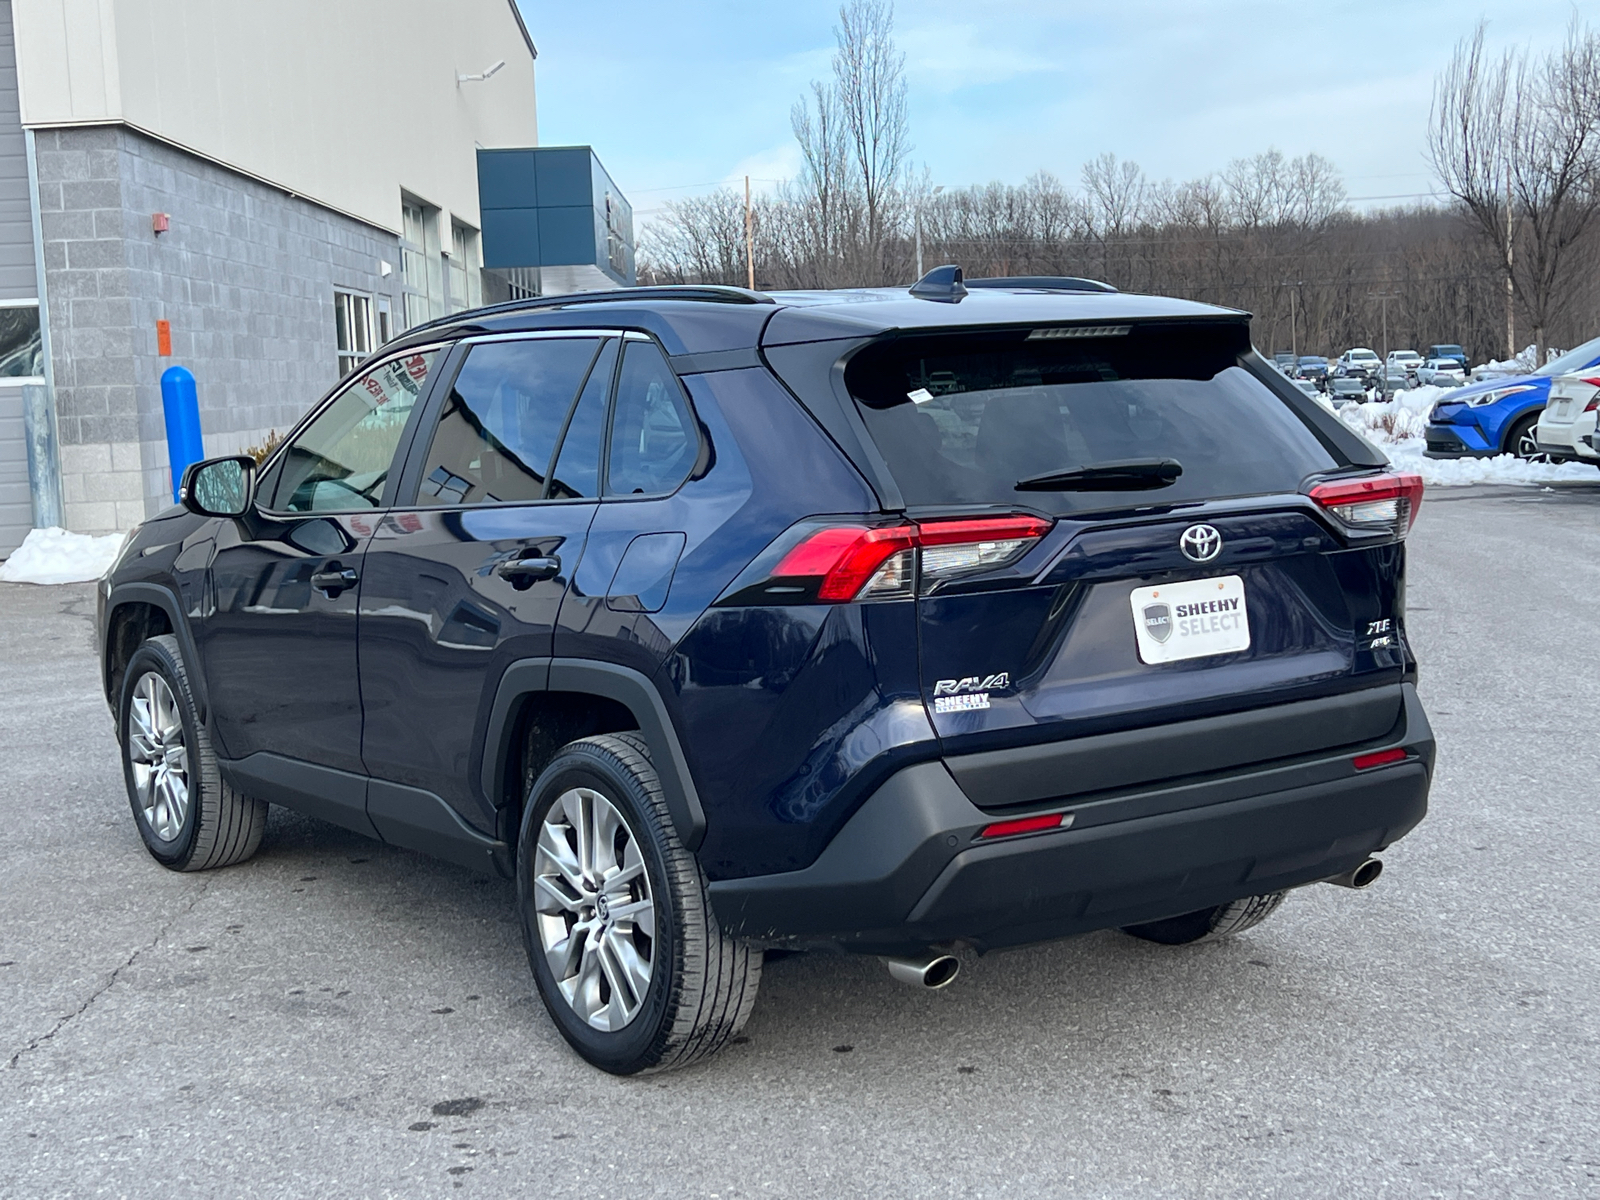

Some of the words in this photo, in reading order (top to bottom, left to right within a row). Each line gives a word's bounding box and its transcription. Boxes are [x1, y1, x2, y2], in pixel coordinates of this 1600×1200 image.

[1175, 597, 1239, 618] SHEEHY
[1145, 615, 1170, 627] SELECT
[1179, 612, 1242, 637] SELECT
[933, 672, 1010, 695] RAV4
[934, 692, 989, 707] SHEEHY
